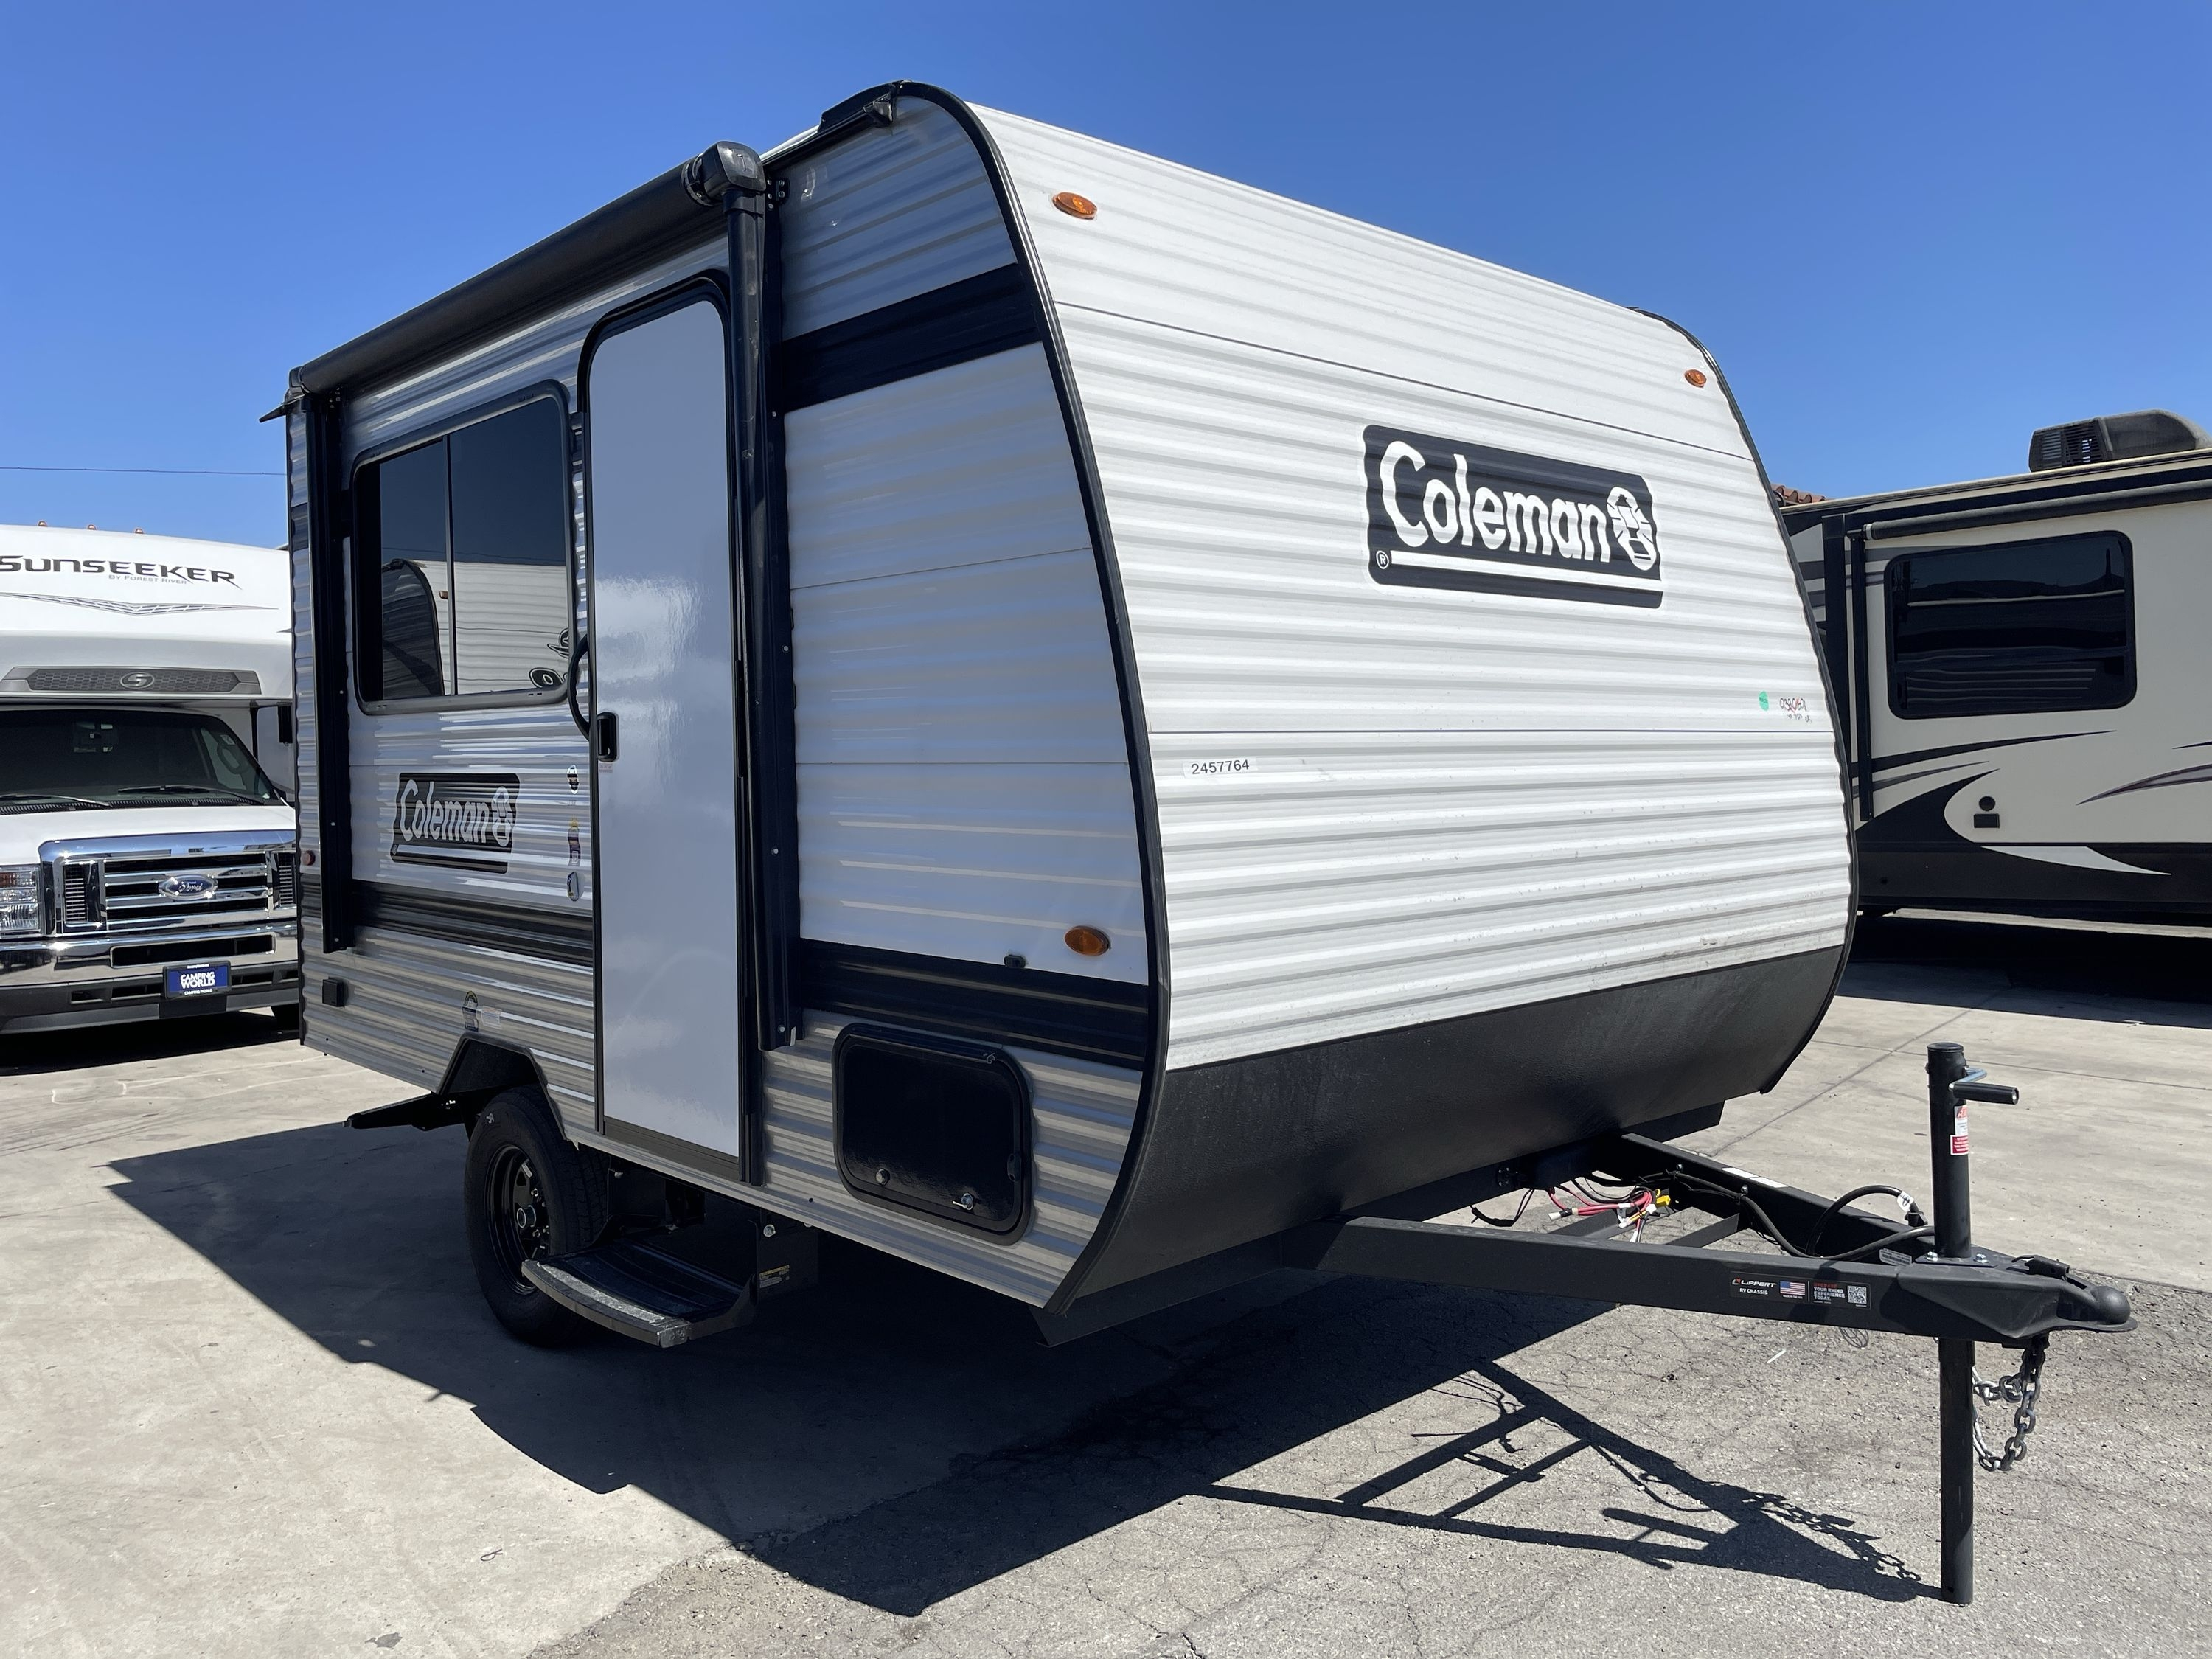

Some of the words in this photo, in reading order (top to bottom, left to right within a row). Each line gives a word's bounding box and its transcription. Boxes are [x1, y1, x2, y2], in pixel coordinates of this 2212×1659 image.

[1380, 441, 1610, 563] Coleman
[1191, 759, 1249, 774] 2457764
[400, 779, 490, 843] Coleman
[181, 972, 215, 981] CAMPING
[181, 978, 215, 989] WORLD
